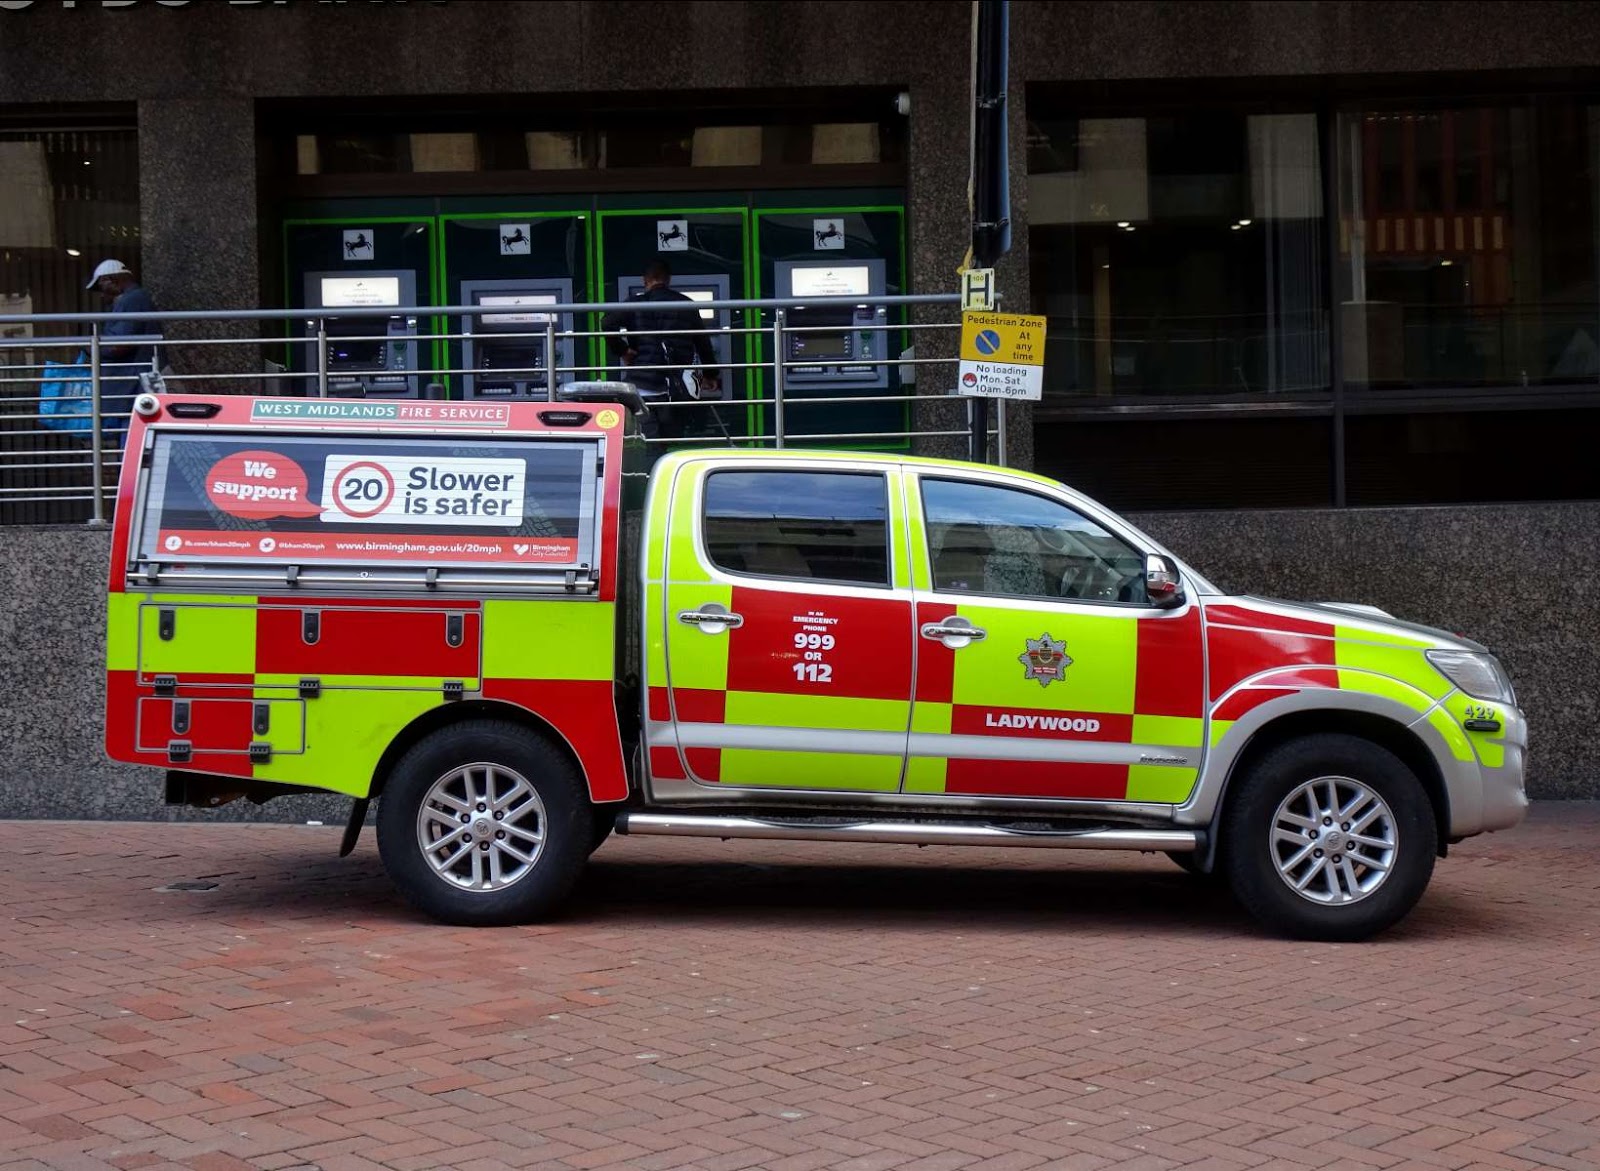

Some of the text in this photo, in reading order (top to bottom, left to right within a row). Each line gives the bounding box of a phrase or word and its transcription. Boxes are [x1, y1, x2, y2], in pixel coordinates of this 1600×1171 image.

[967, 314, 1043, 328] Pedestrian Zone
[1019, 331, 1030, 340] At
[1015, 342, 1033, 352] any
[1012, 352, 1034, 361] time
[976, 364, 1027, 377] No loading
[259, 404, 505, 419] WEST MIDLANDS FIRE SERVICE
[244, 460, 277, 479] We
[406, 466, 515, 492] Slower
[212, 481, 298, 502] support
[344, 478, 383, 501] 20
[404, 491, 513, 516] is safer
[336, 541, 502, 555] www.birmingham.gov.uk/20mph
[532, 544, 571, 552] Birmingham
[793, 615, 839, 625] EMERGENCY
[803, 624, 827, 632] PHONE
[794, 632, 836, 651] 999
[804, 651, 822, 661] OR
[792, 662, 833, 683] 112
[1465, 705, 1496, 719] 429
[985, 713, 1101, 733] LADYWOOD
